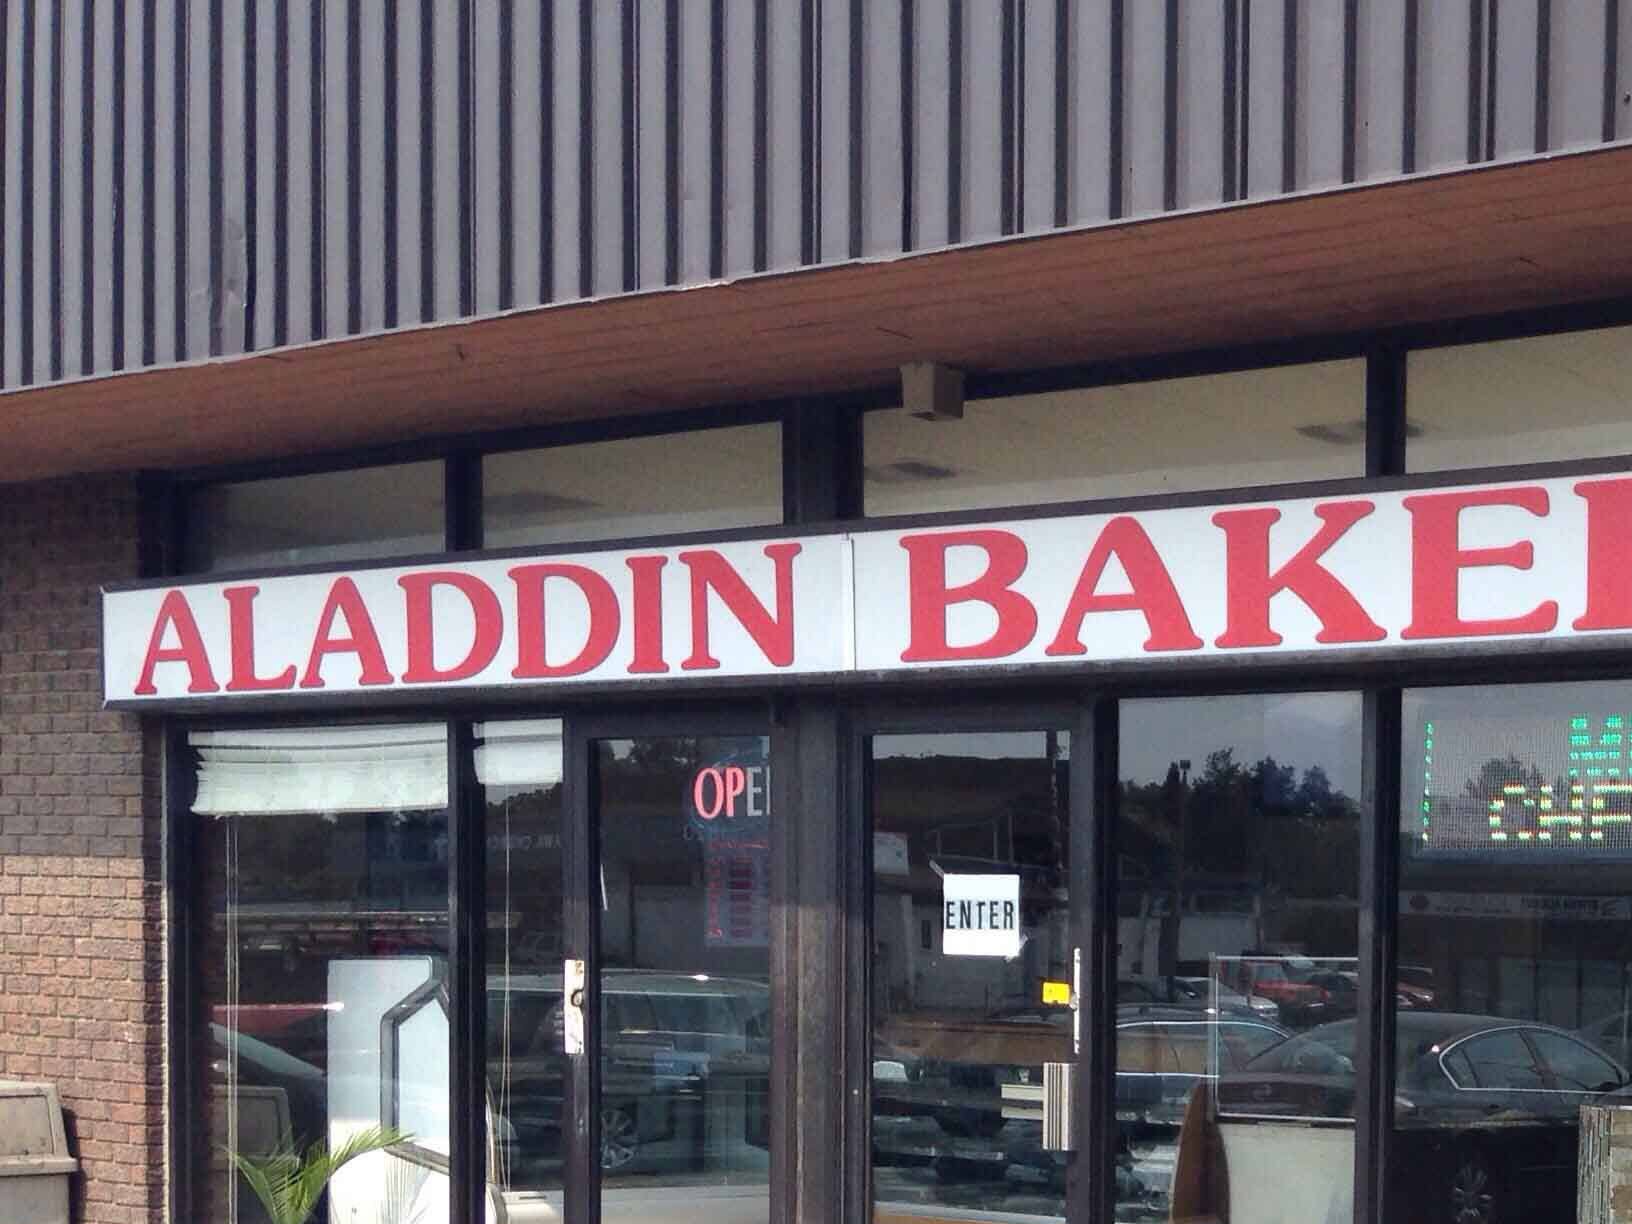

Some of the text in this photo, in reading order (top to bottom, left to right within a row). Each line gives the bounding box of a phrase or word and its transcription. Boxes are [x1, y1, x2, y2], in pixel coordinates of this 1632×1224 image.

[134, 542, 802, 696] ALADDIN
[694, 766, 770, 819] OPE
[945, 899, 1014, 930] ENTER
